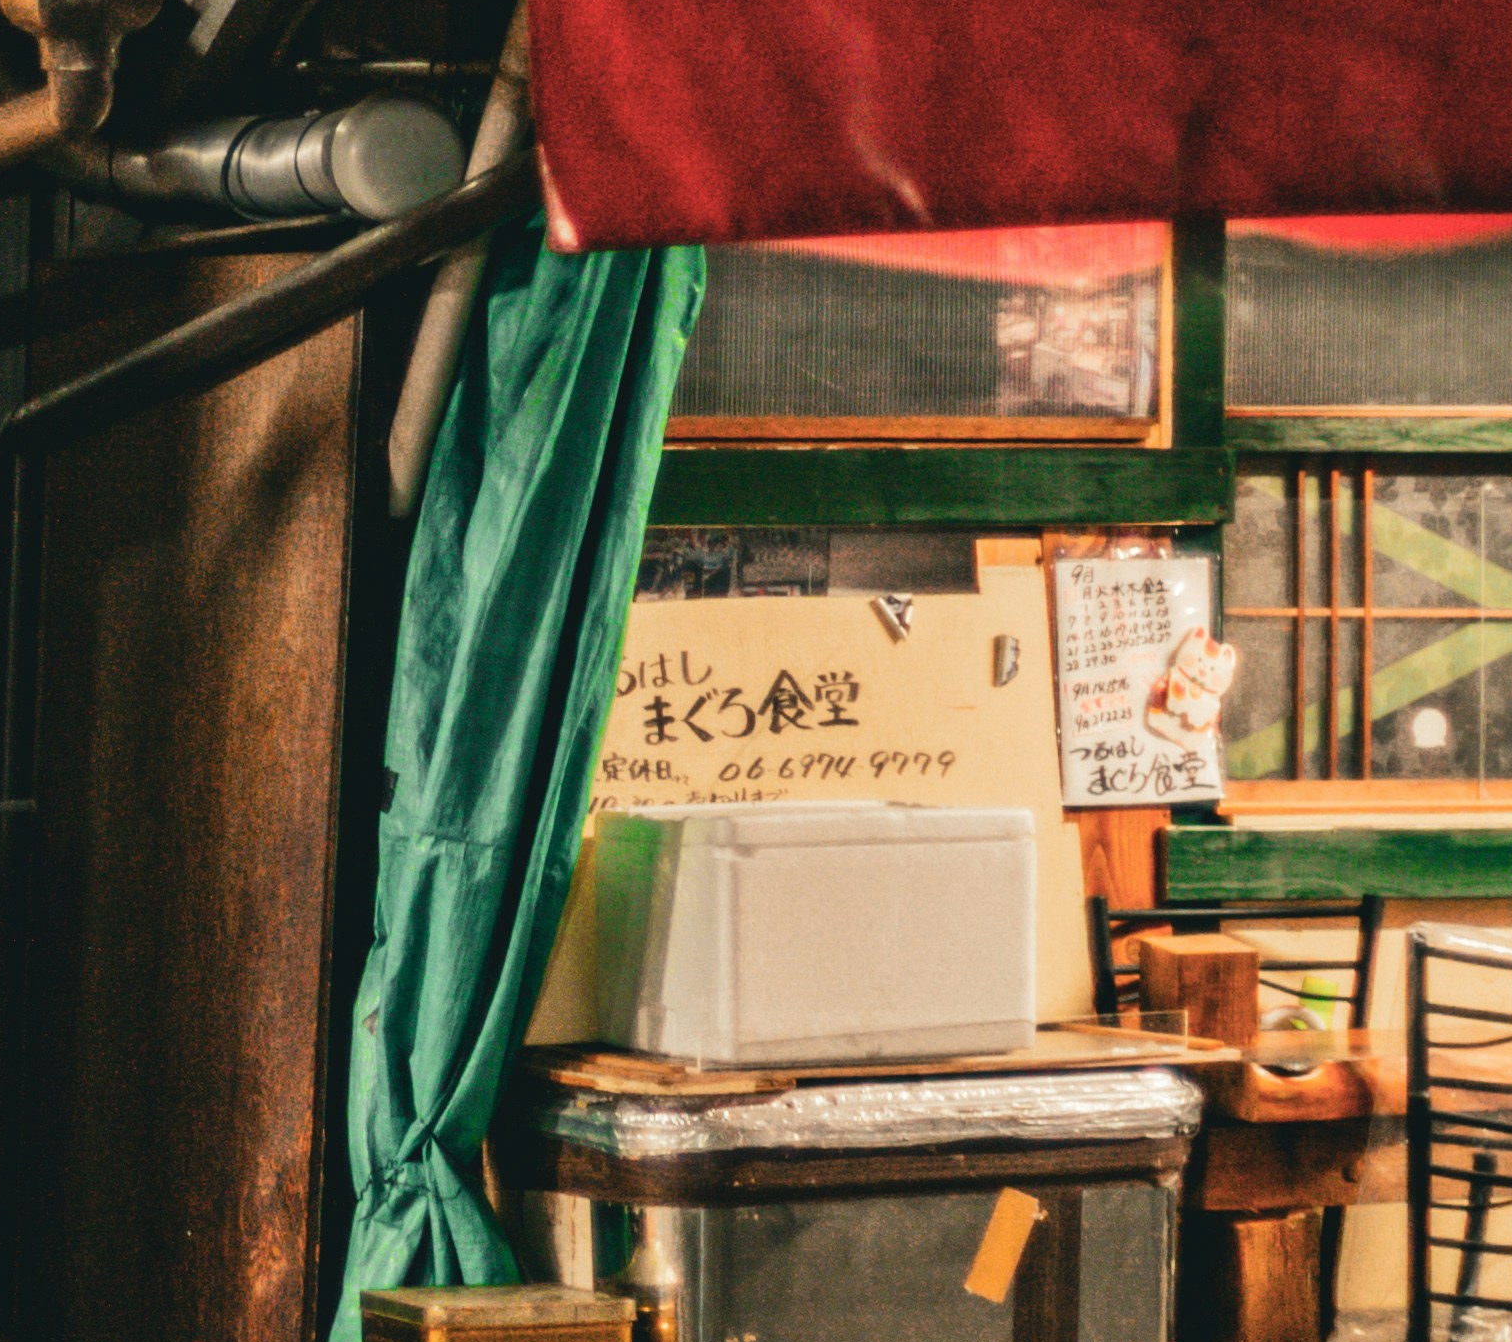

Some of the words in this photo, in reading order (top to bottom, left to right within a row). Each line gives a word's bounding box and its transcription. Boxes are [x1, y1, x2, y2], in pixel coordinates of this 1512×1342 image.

[643, 669, 860, 745] まぐろ食堂
